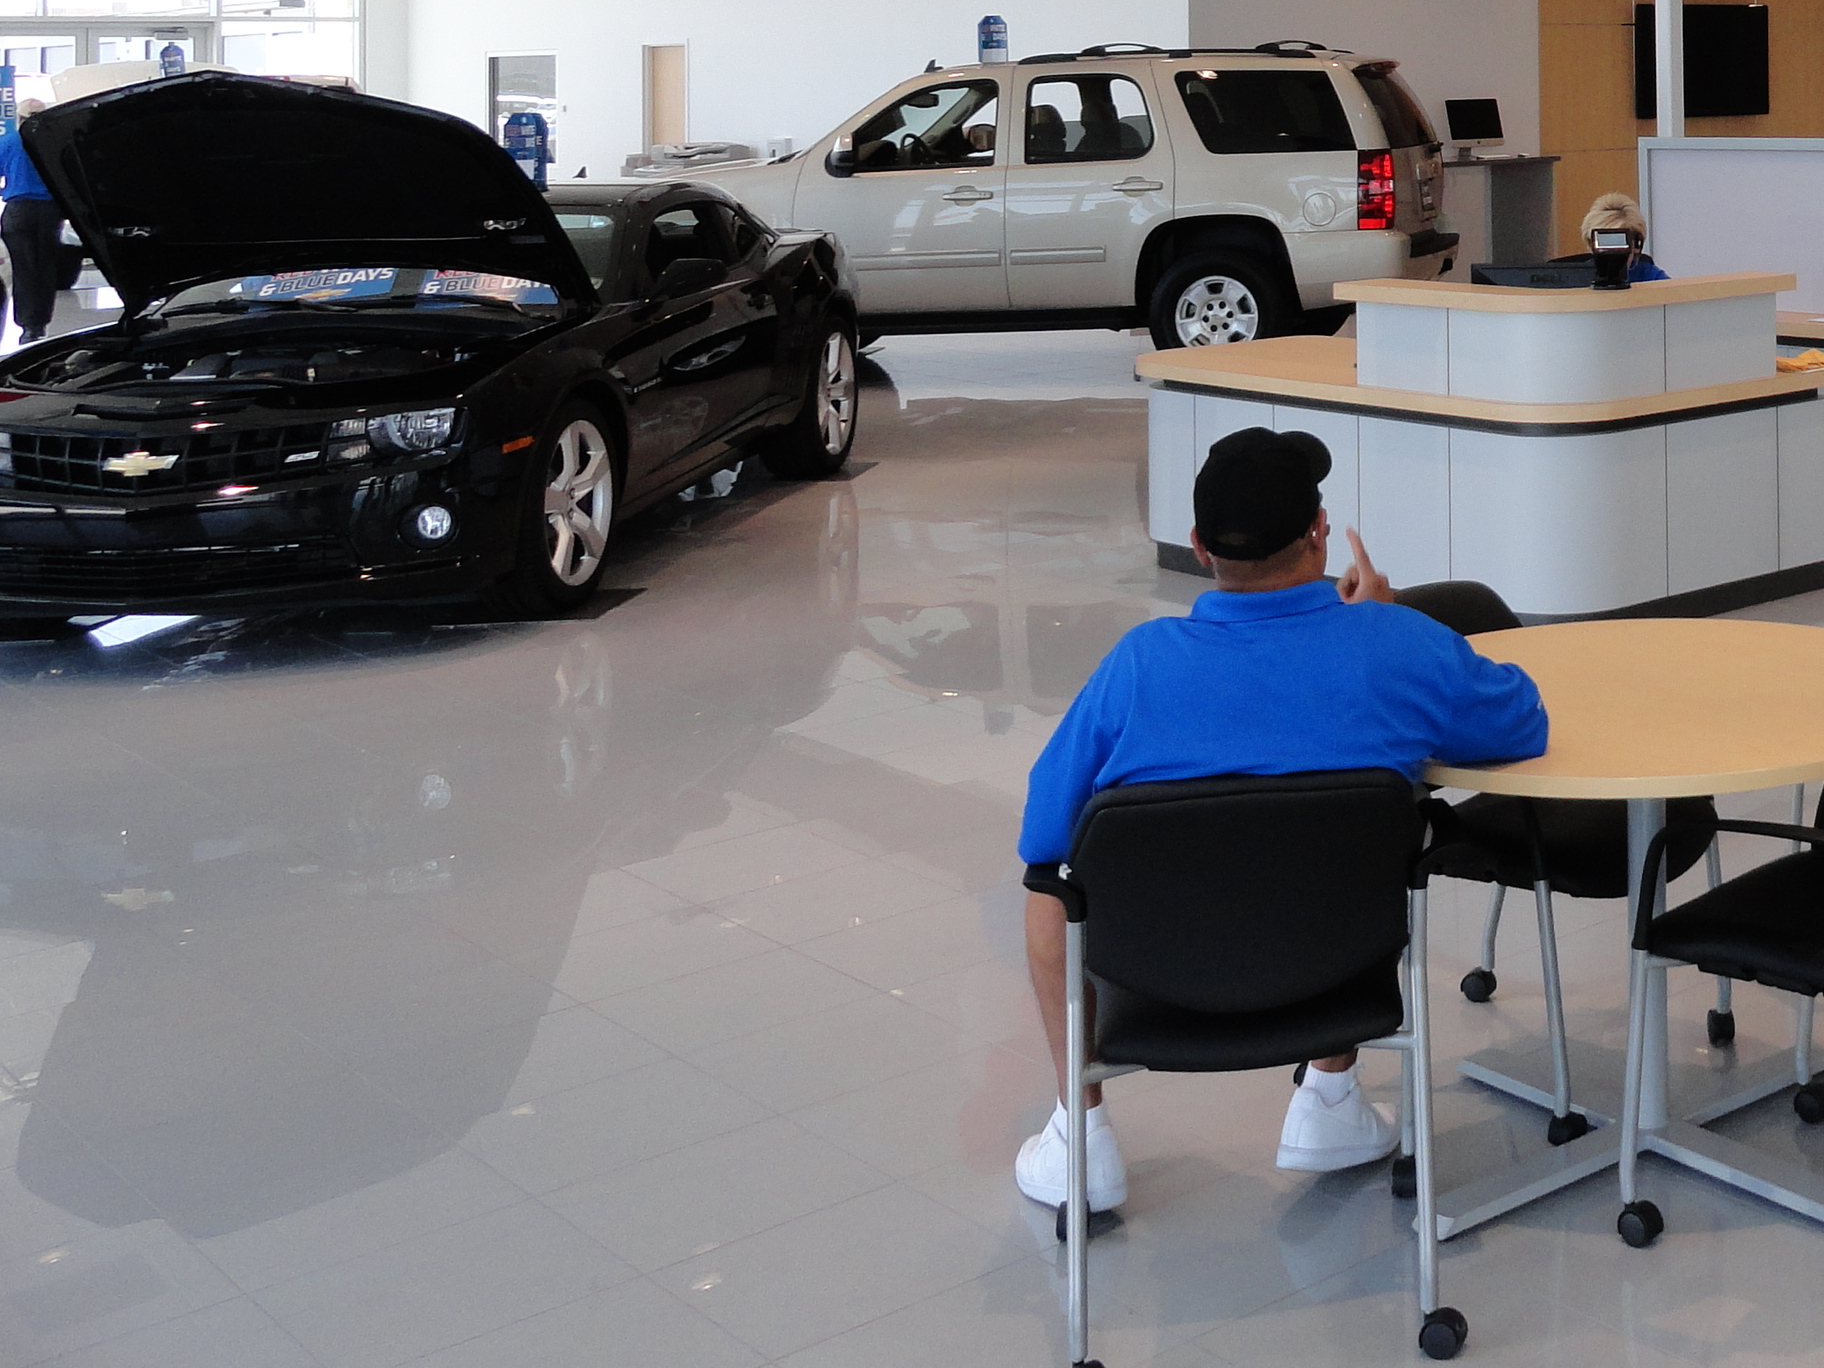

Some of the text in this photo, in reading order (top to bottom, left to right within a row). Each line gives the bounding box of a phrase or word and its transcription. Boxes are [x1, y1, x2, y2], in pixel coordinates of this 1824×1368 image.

[259, 267, 396, 297] & BLUE DAYS
[423, 280, 442, 294] &
[443, 276, 501, 293] BLUE
